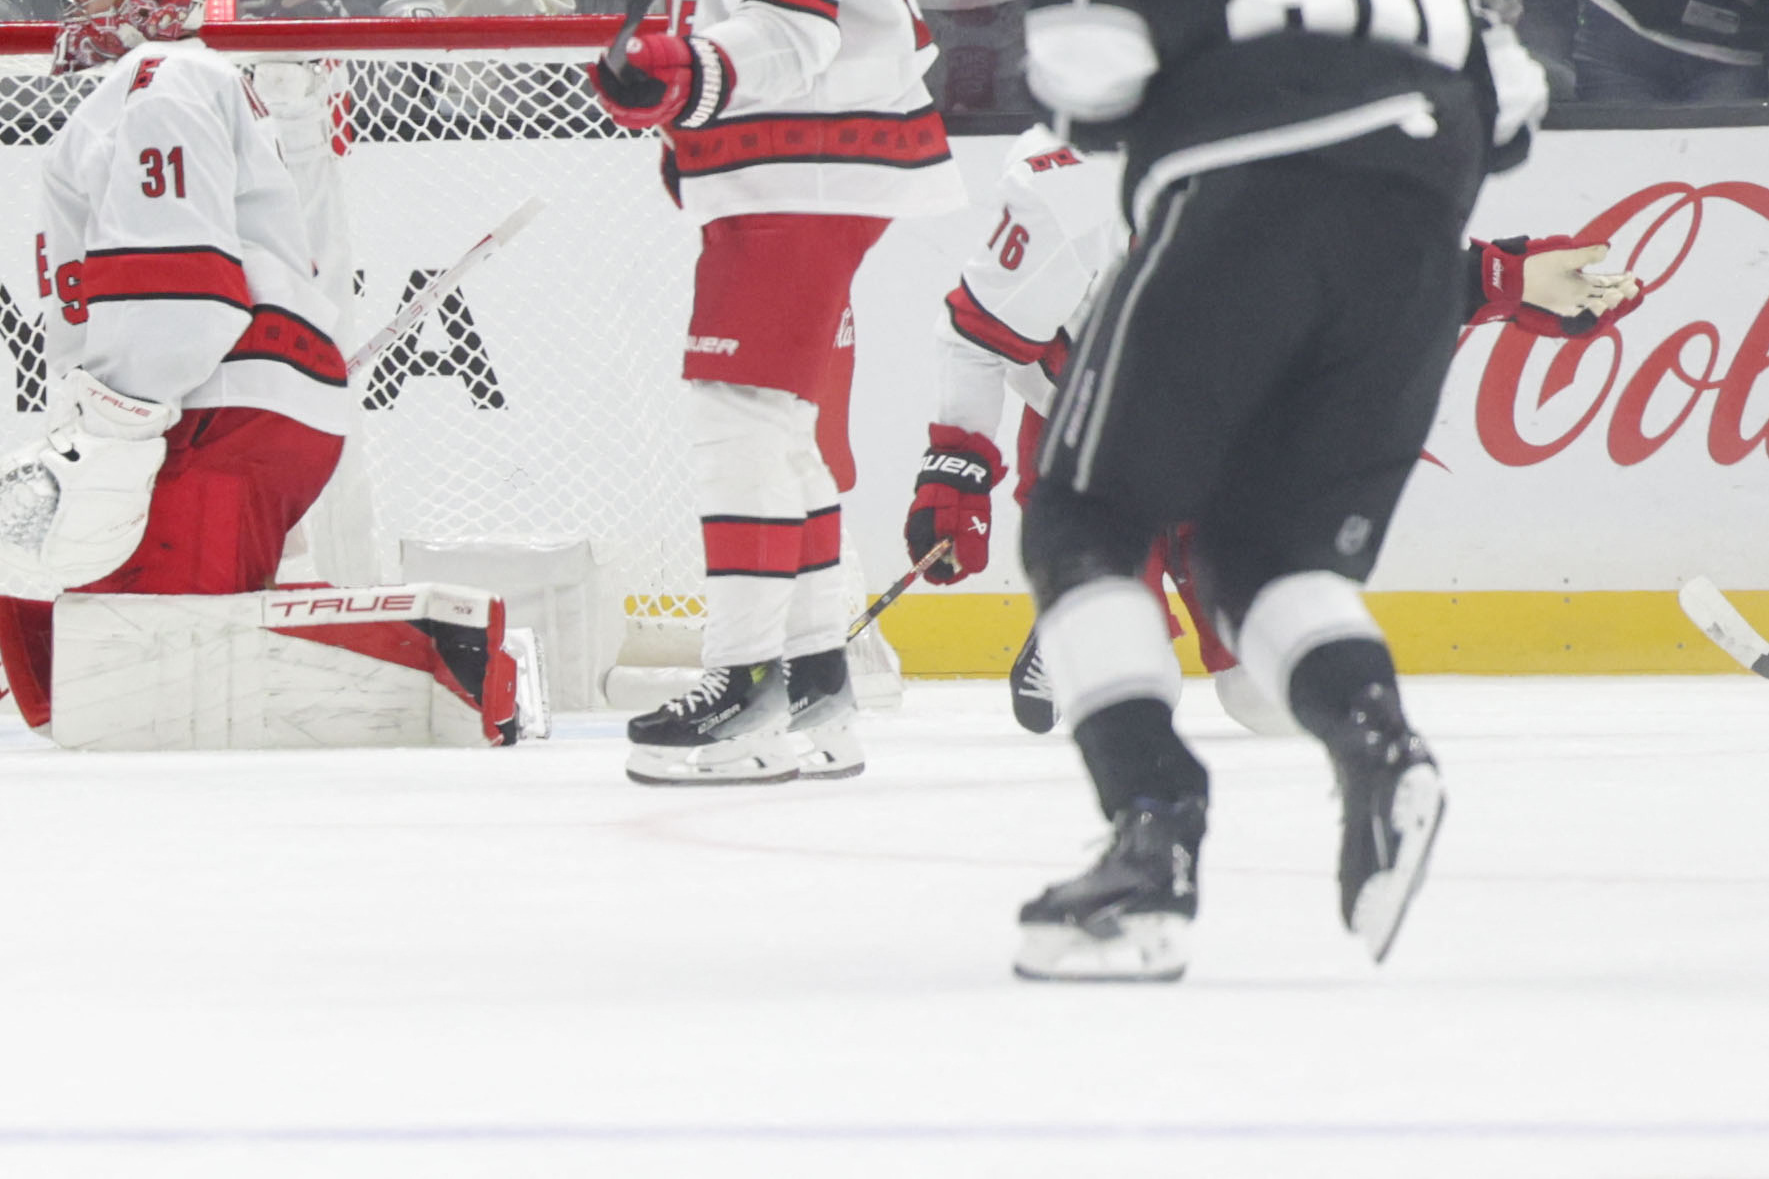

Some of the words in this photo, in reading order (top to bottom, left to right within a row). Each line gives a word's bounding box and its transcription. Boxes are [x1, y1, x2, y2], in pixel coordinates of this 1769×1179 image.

[139, 145, 186, 199] 31
[1475, 180, 1769, 467] Col
[87, 386, 152, 418] TRUE
[920, 453, 987, 484] UER
[271, 594, 417, 618] TRUE
